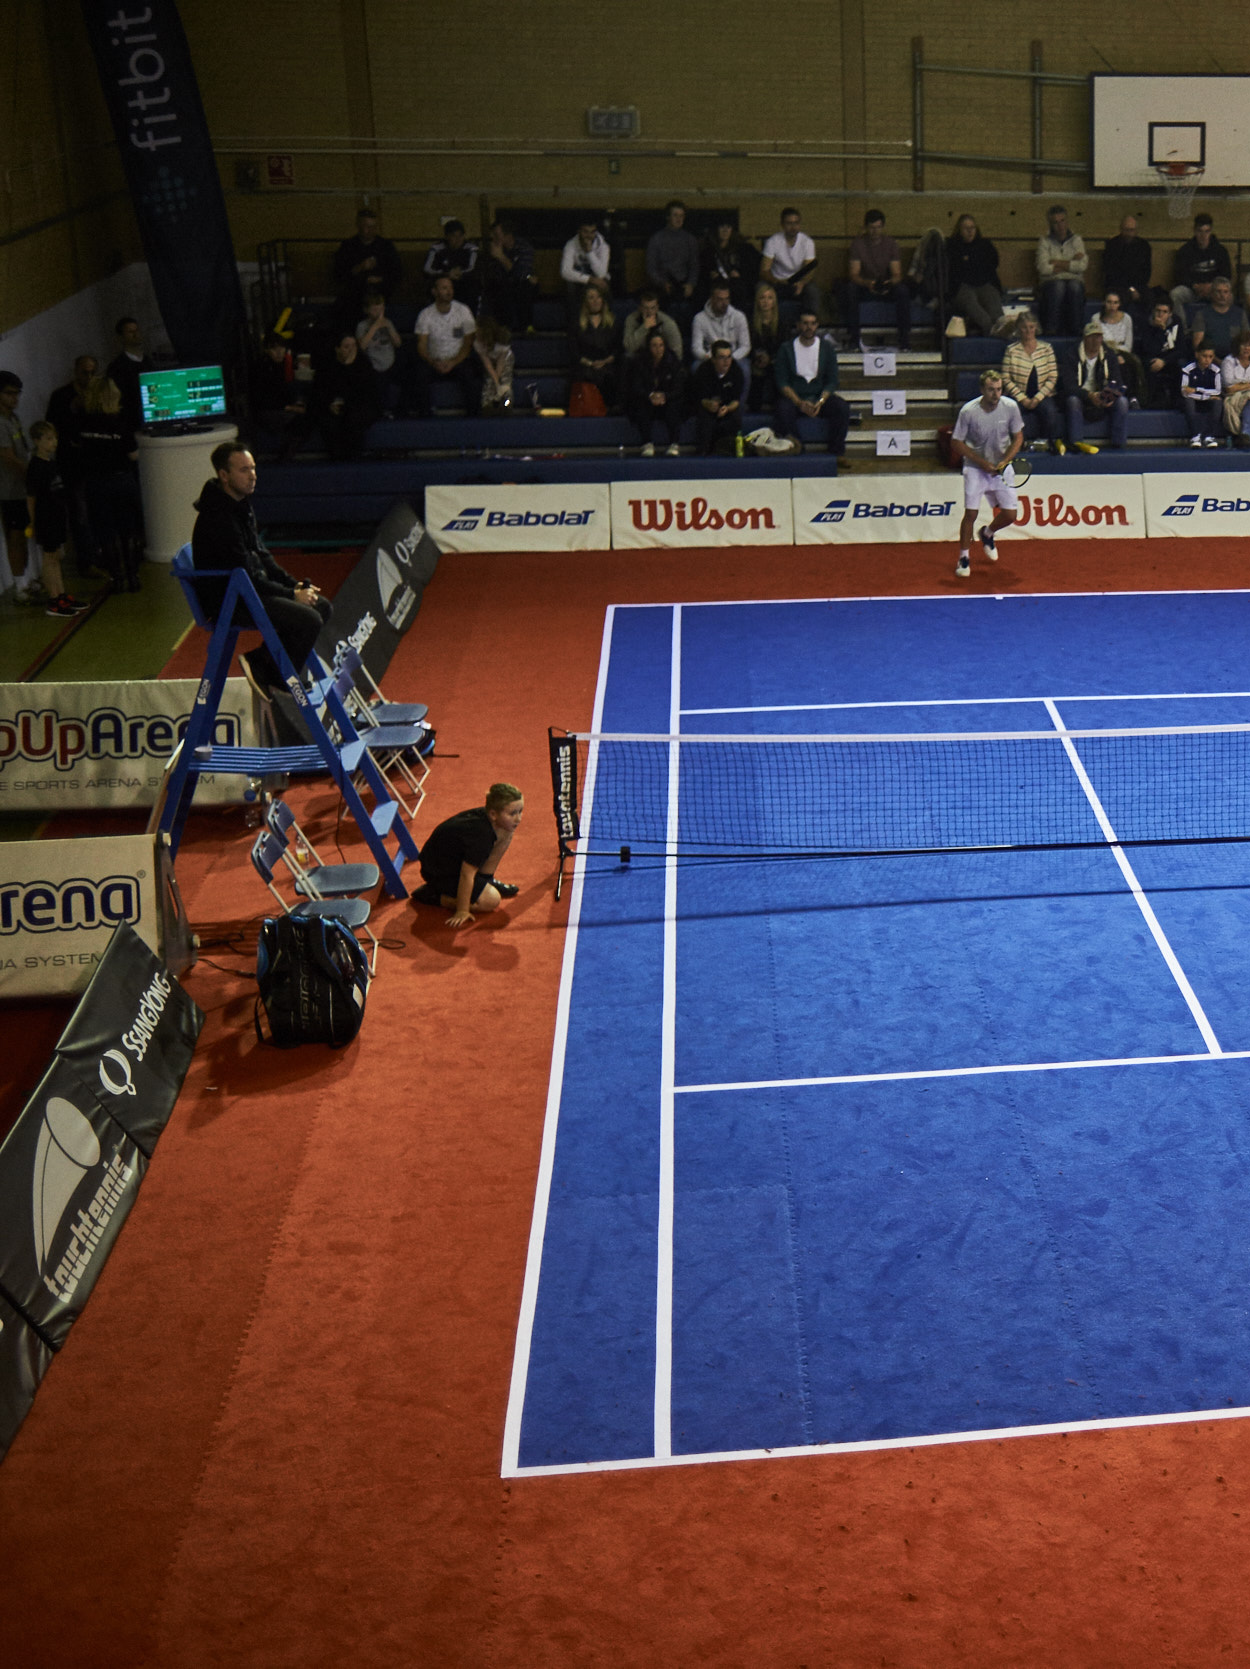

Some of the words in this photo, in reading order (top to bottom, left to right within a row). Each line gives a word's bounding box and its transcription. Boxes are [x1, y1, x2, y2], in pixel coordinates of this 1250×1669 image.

[107, 7, 182, 151] fitbit
[874, 357, 884, 368] C
[885, 399, 893, 410] B
[888, 438, 897, 449] A
[629, 498, 775, 531] Wilson
[13, 779, 80, 790] SPORTS
[85, 777, 142, 789] ARENA
[122, 972, 171, 1062] SSANGYONG
[43, 1153, 133, 1304] touchtennis
